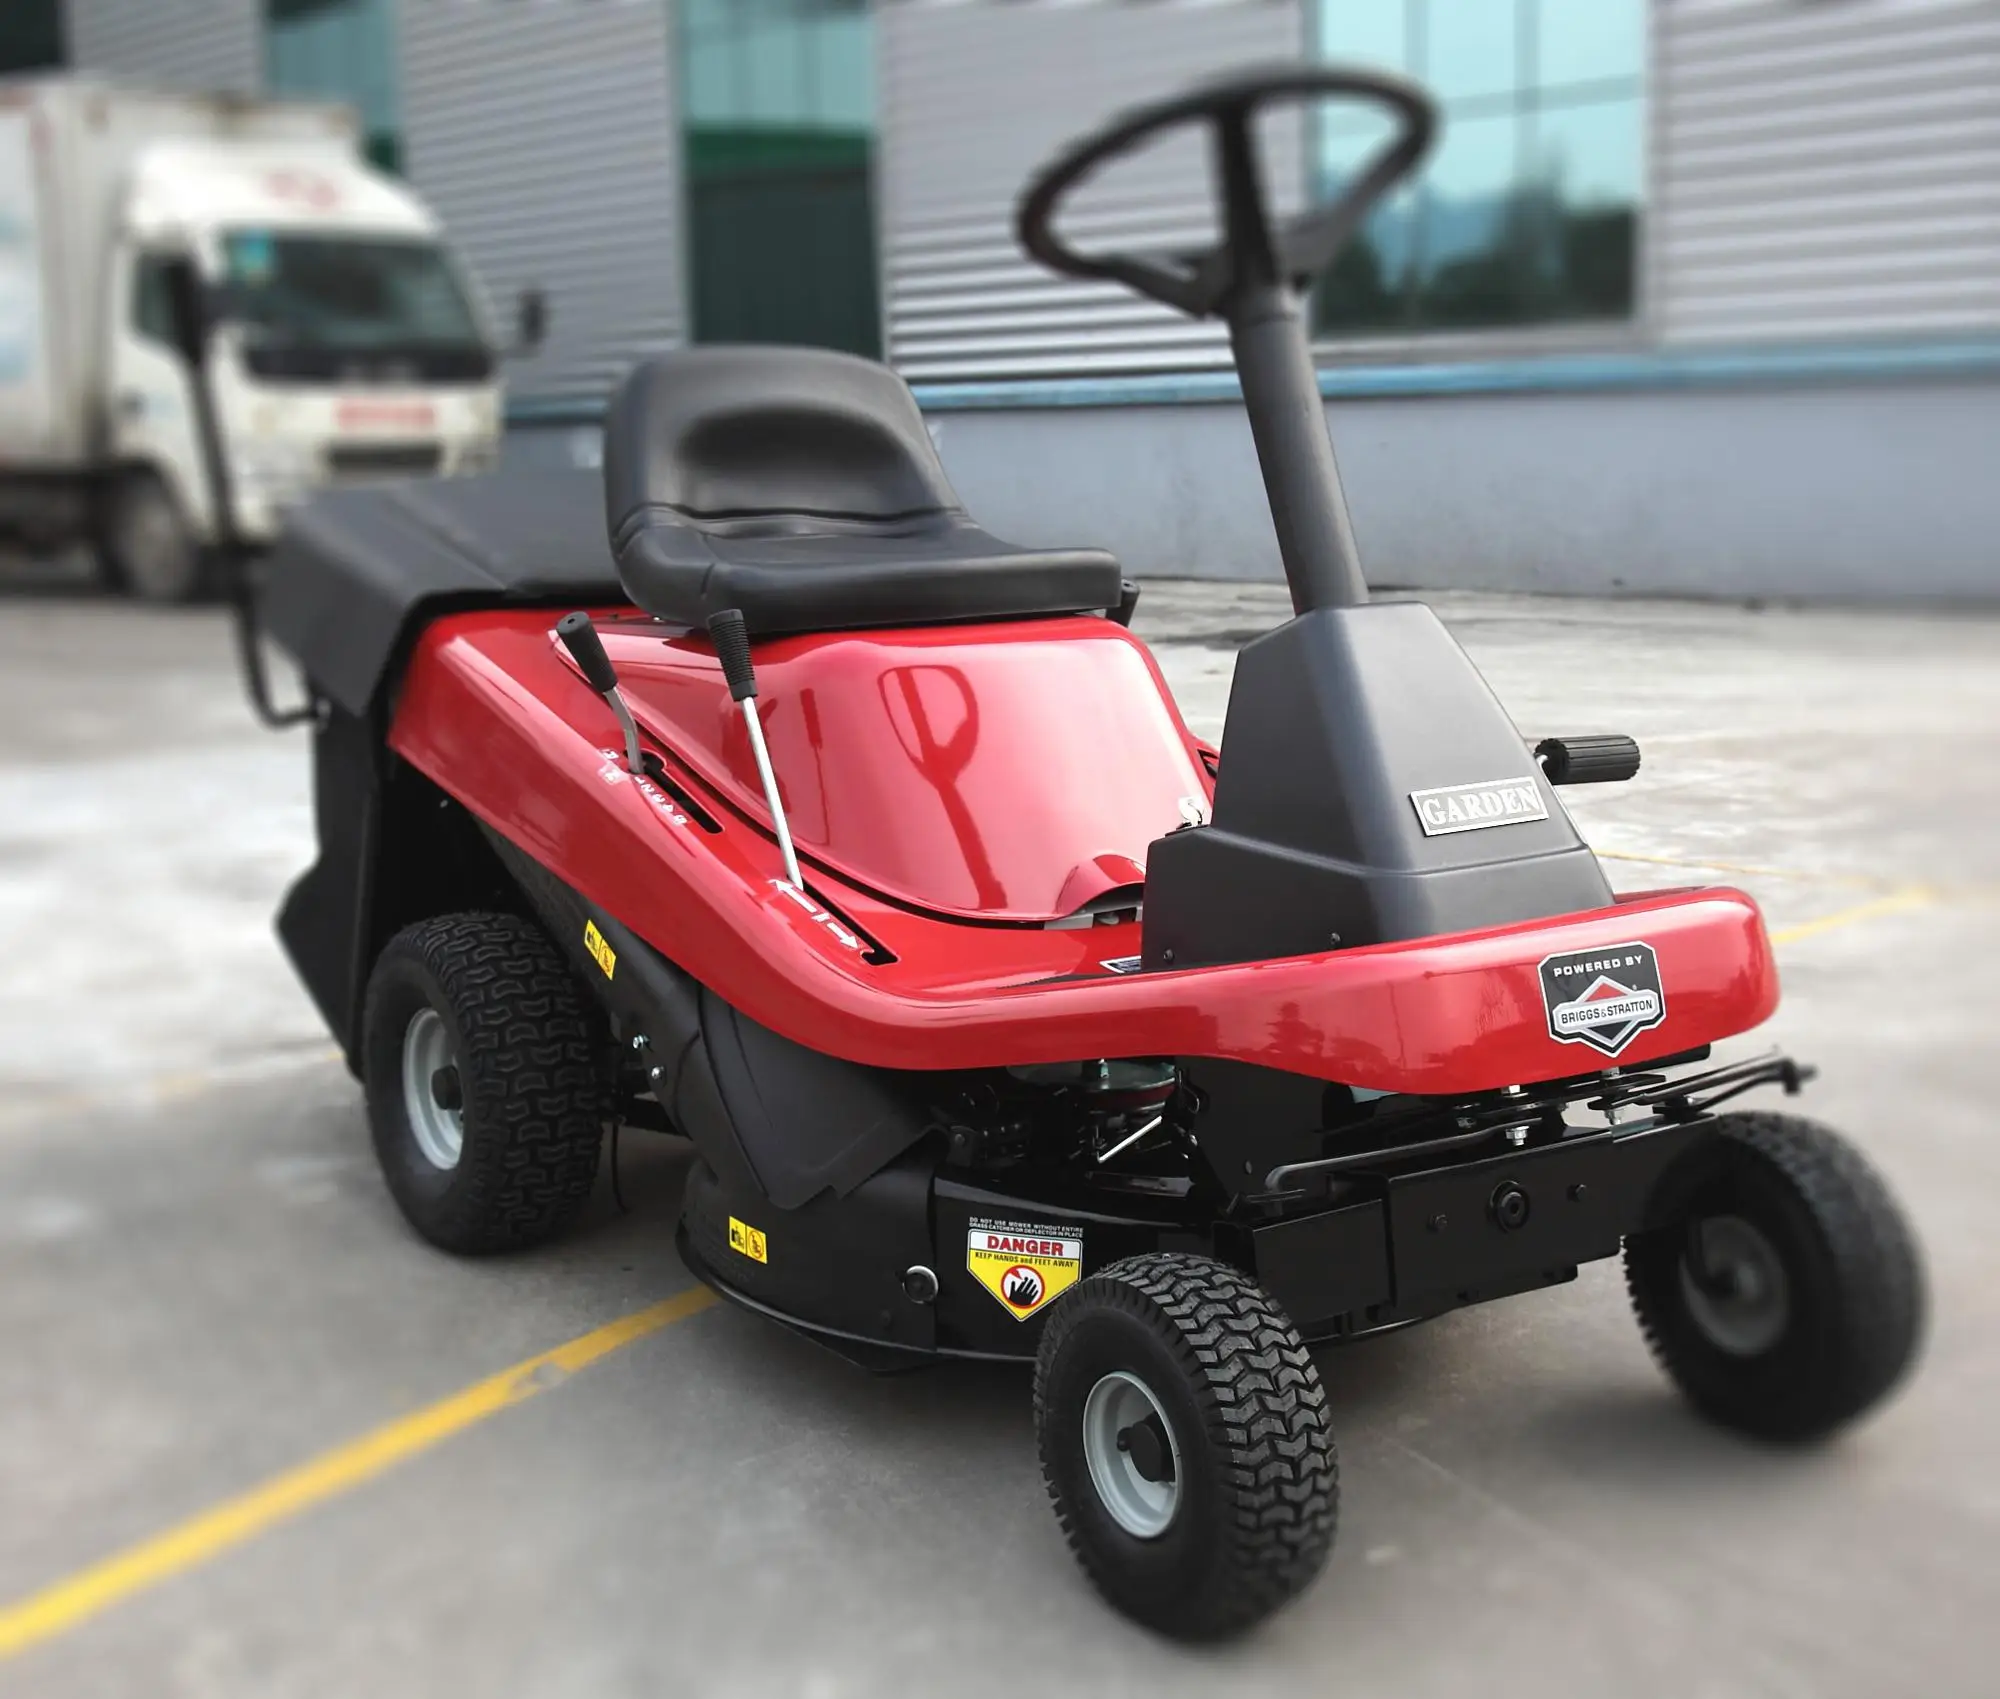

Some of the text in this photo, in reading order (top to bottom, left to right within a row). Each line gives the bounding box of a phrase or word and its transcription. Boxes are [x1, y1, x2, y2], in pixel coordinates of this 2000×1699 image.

[1421, 785, 1540, 825] GARDEN
[1553, 955, 1642, 977] POWERED BY
[988, 1224, 1015, 1232] CATCHER
[1024, 1228, 1057, 1236] DEFLECTOR
[1008, 1221, 1032, 1229] MOWER
[987, 1235, 1064, 1256] DANGER
[975, 1252, 992, 1260] KEEP
[993, 1254, 1019, 1263] HANDS
[1034, 1258, 1051, 1266] FEET
[1053, 1260, 1075, 1268] AWAY
